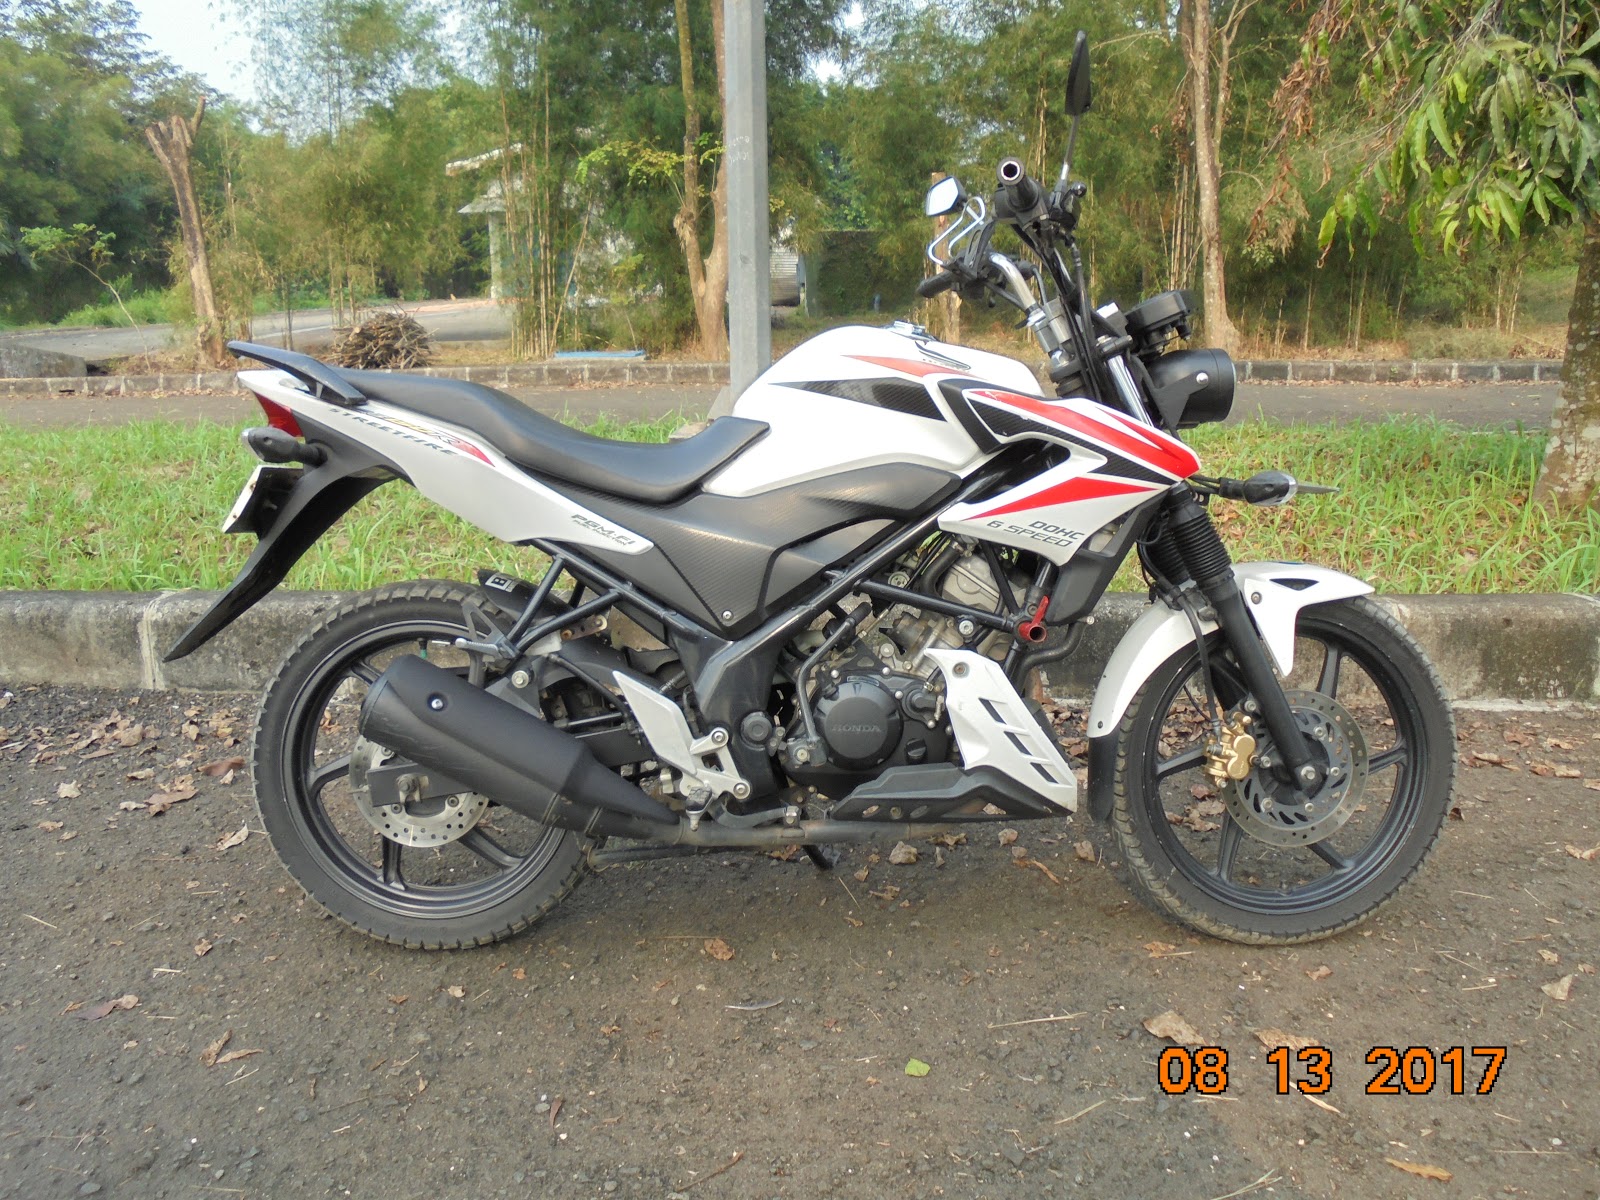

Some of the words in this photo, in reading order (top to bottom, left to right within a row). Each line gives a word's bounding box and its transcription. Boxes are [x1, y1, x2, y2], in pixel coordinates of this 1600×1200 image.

[328, 408, 458, 454] STREETFIRE
[986, 520, 1004, 529] 6
[1003, 525, 1073, 547] SPEED
[1028, 520, 1085, 540] DOHC
[831, 724, 882, 733] HONDA
